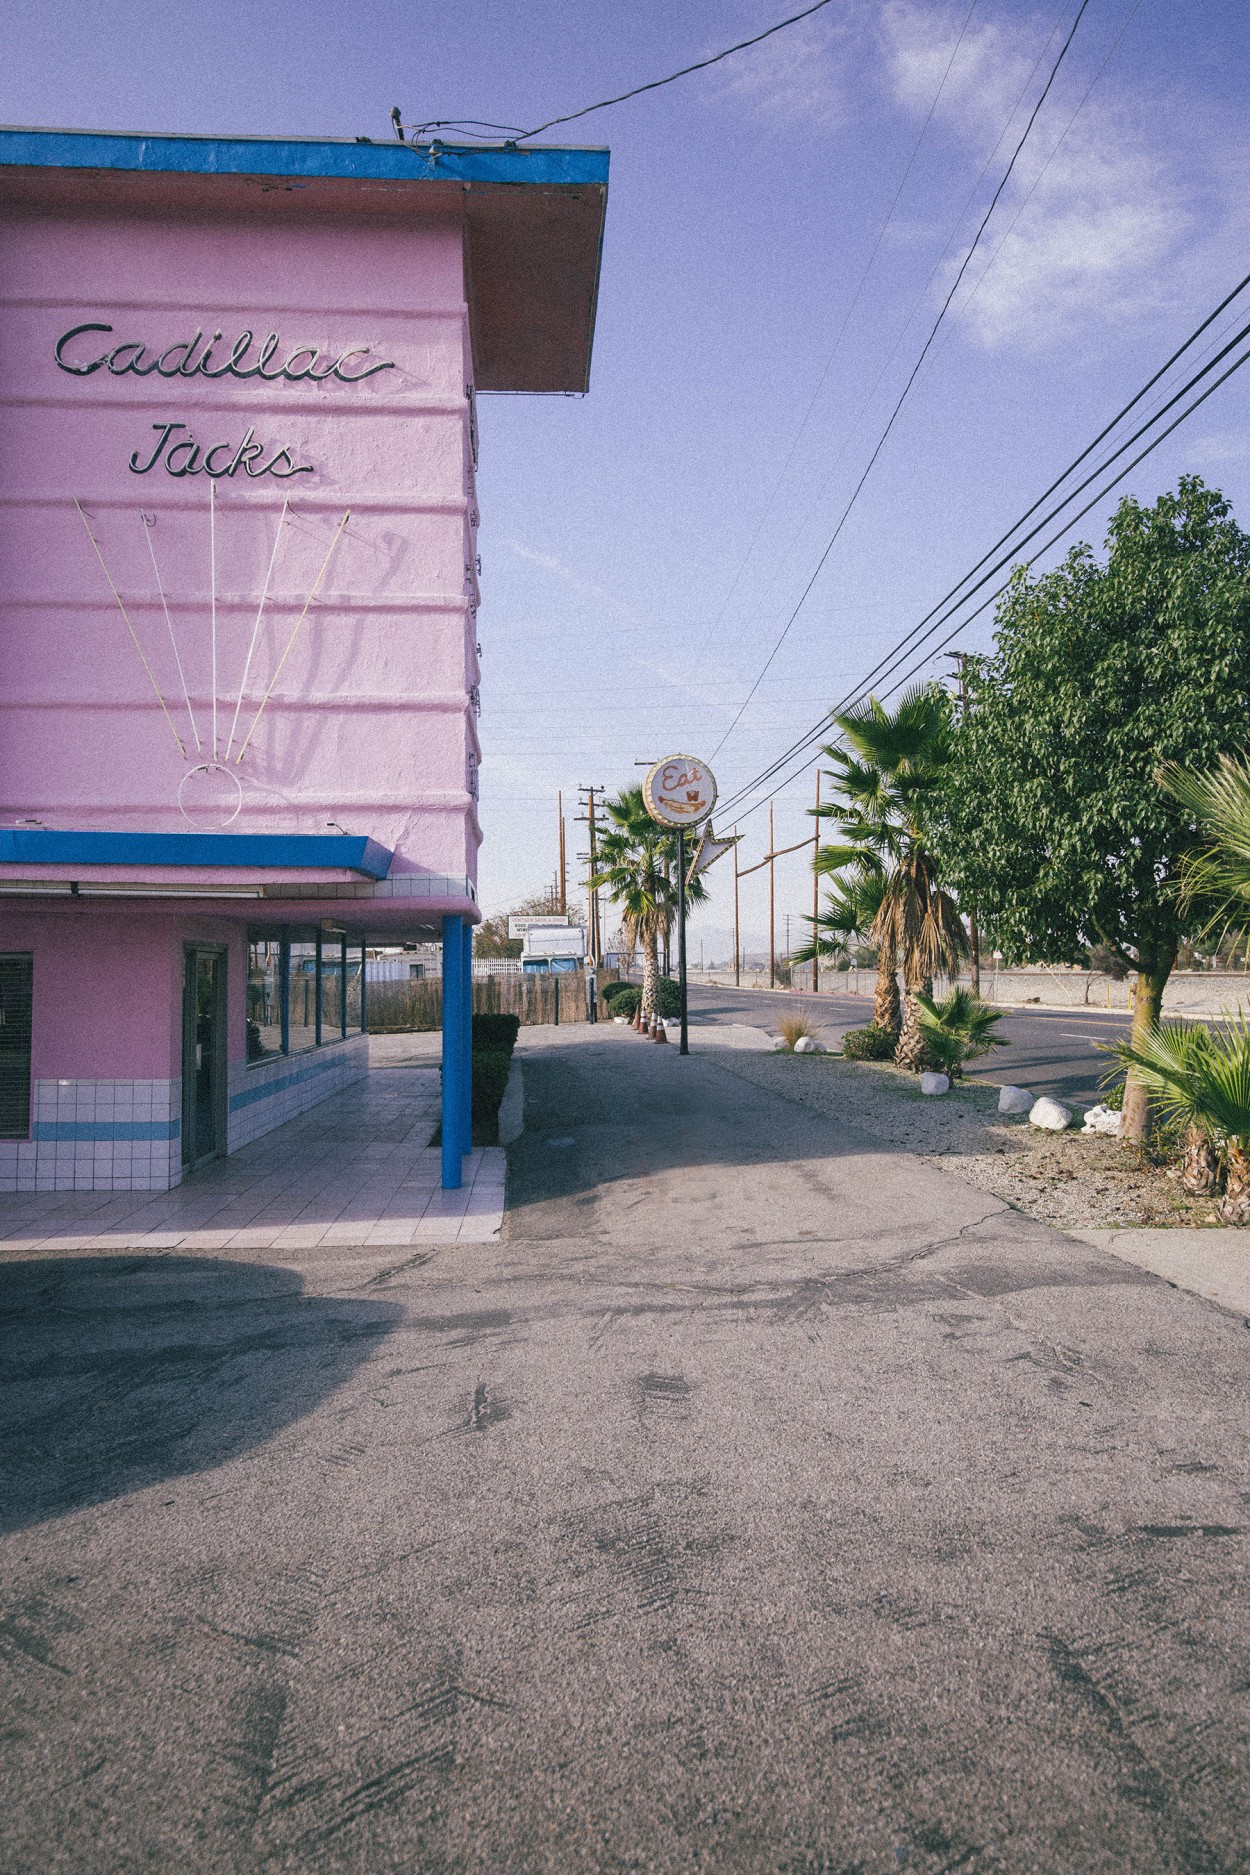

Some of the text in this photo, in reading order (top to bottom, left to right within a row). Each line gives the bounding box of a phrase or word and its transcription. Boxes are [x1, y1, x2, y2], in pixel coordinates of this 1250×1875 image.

[54, 322, 395, 382] Cadillac
[129, 422, 313, 478] Jacks
[662, 765, 702, 791] Eat
